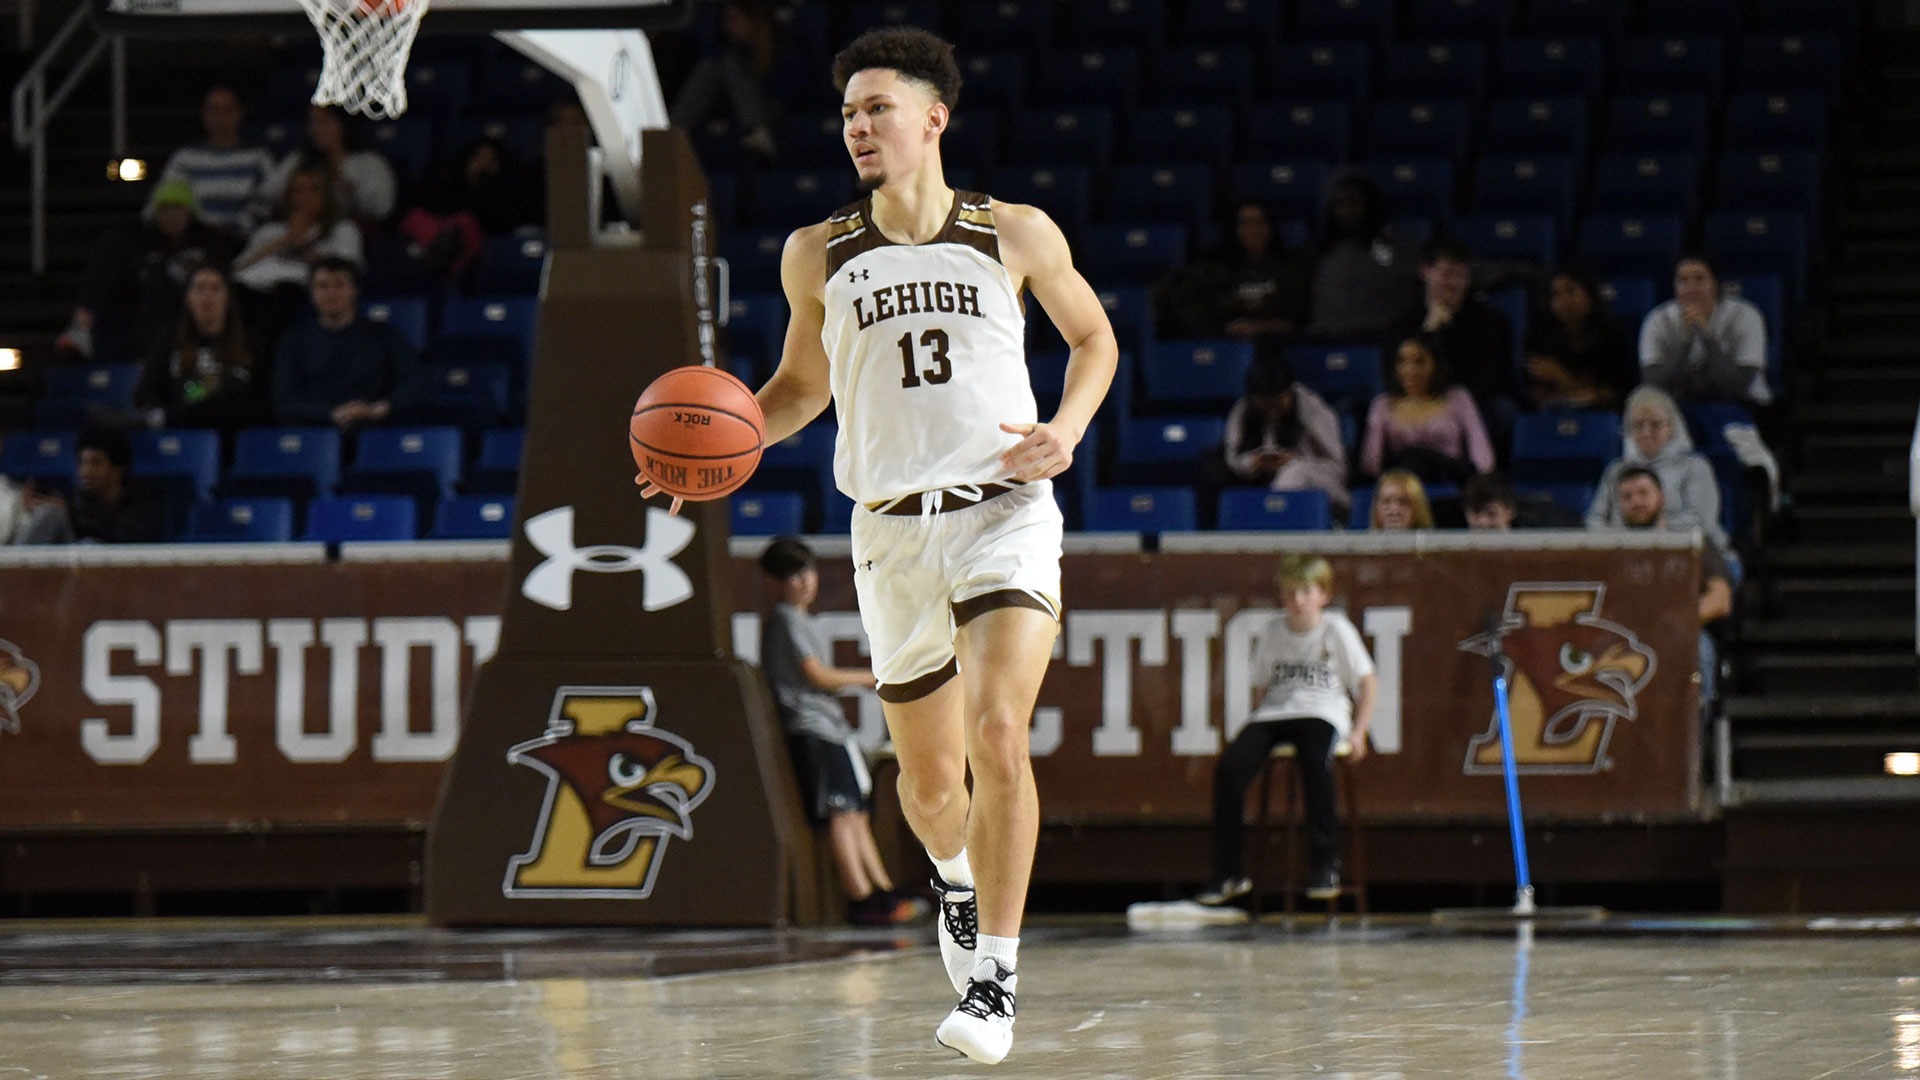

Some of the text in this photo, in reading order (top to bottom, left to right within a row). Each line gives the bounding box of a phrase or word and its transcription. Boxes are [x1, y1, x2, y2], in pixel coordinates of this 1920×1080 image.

[853, 281, 982, 331] LEHIGH
[897, 328, 953, 389] 13
[673, 412, 711, 426] ROCK
[645, 455, 735, 489] THE ROCK
[81, 616, 762, 764] STUD
